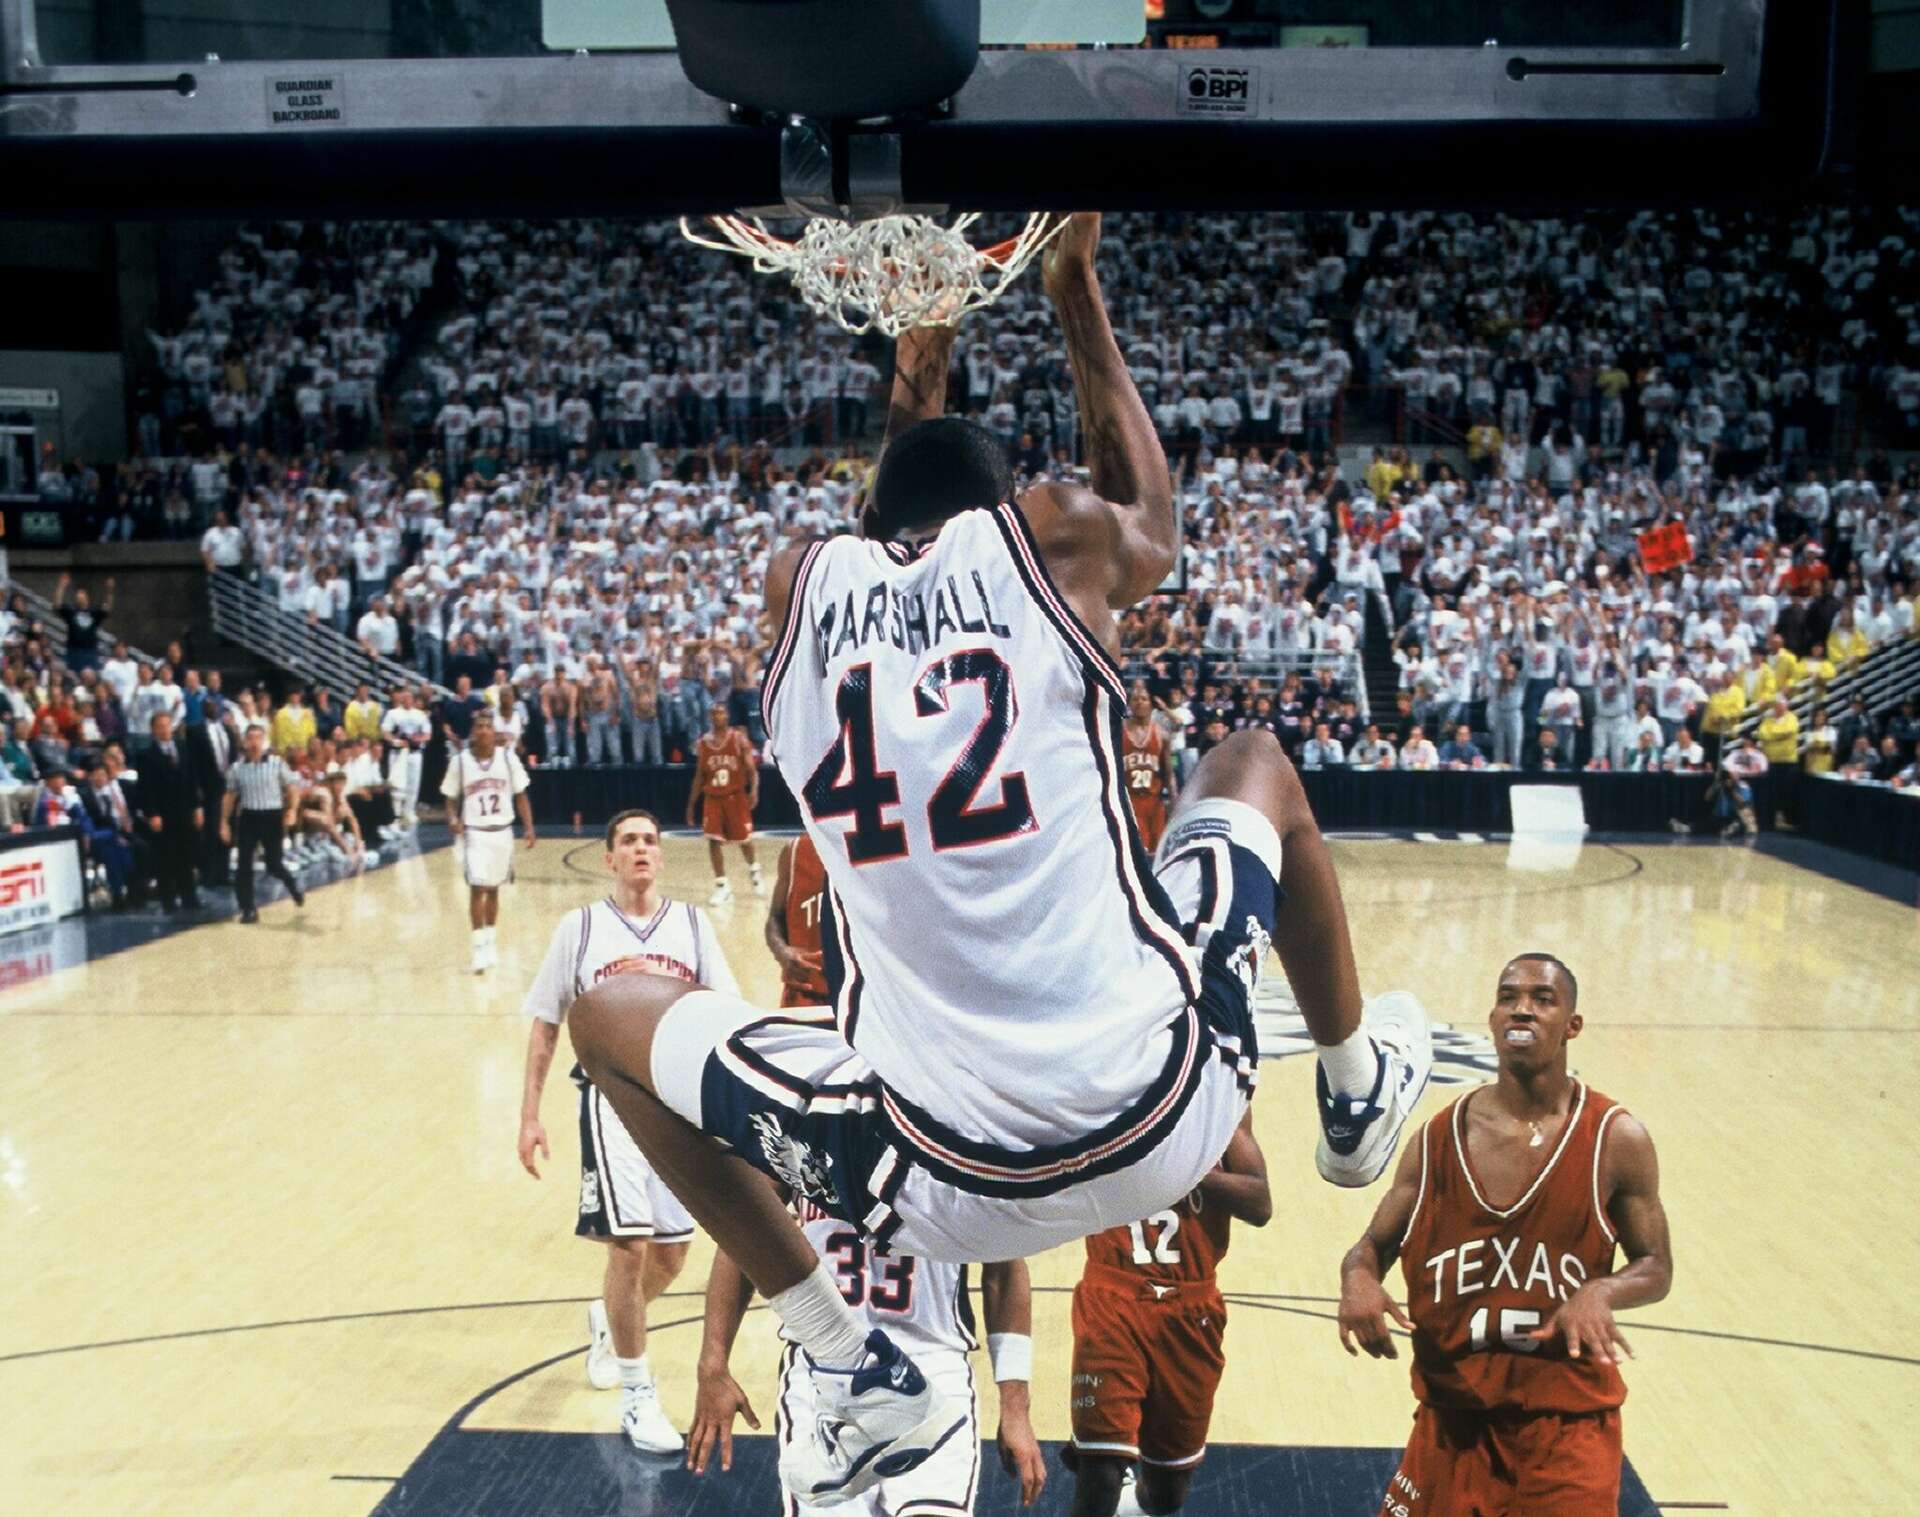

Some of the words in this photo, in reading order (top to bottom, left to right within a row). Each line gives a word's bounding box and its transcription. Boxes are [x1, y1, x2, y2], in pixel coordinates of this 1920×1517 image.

[275, 80, 333, 92] GUARDIAN
[287, 95, 323, 107] GLASS
[1209, 70, 1248, 98] BPI
[272, 108, 340, 123] BACKBOARD
[801, 647, 1041, 867] 42
[478, 794, 501, 816] 12
[1129, 1209, 1181, 1264] 12
[825, 1231, 915, 1313] 33
[1425, 1236, 1587, 1304] TEXAS
[1470, 1307, 1540, 1351] 15
